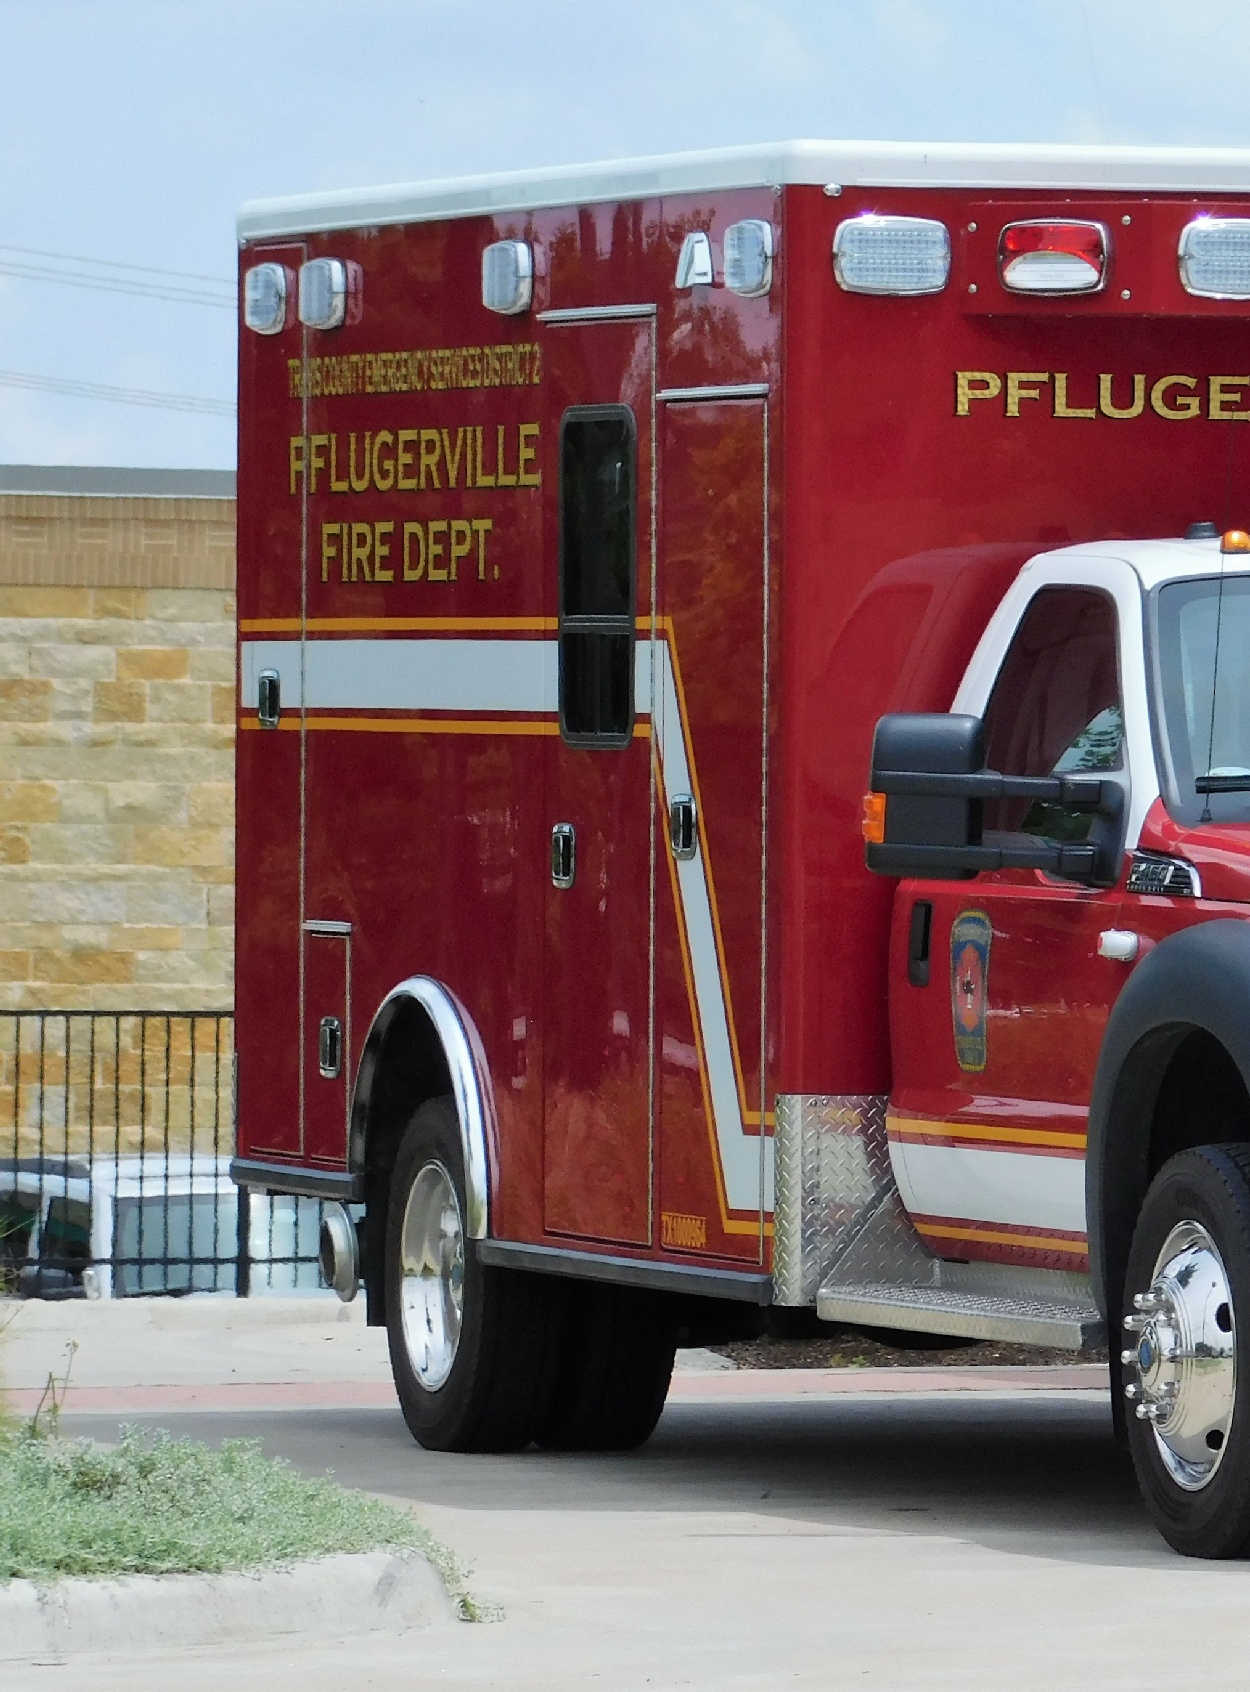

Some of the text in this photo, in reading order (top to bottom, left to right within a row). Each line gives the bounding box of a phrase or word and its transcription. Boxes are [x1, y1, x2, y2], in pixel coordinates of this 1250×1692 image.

[365, 349, 429, 394] EMERGENCY
[430, 346, 481, 390] SERVICES
[483, 343, 532, 386] DISTRICT
[532, 341, 541, 385] 2
[289, 422, 541, 495] PFLUGERVILLE
[320, 518, 501, 582] FIRE DEPT.
